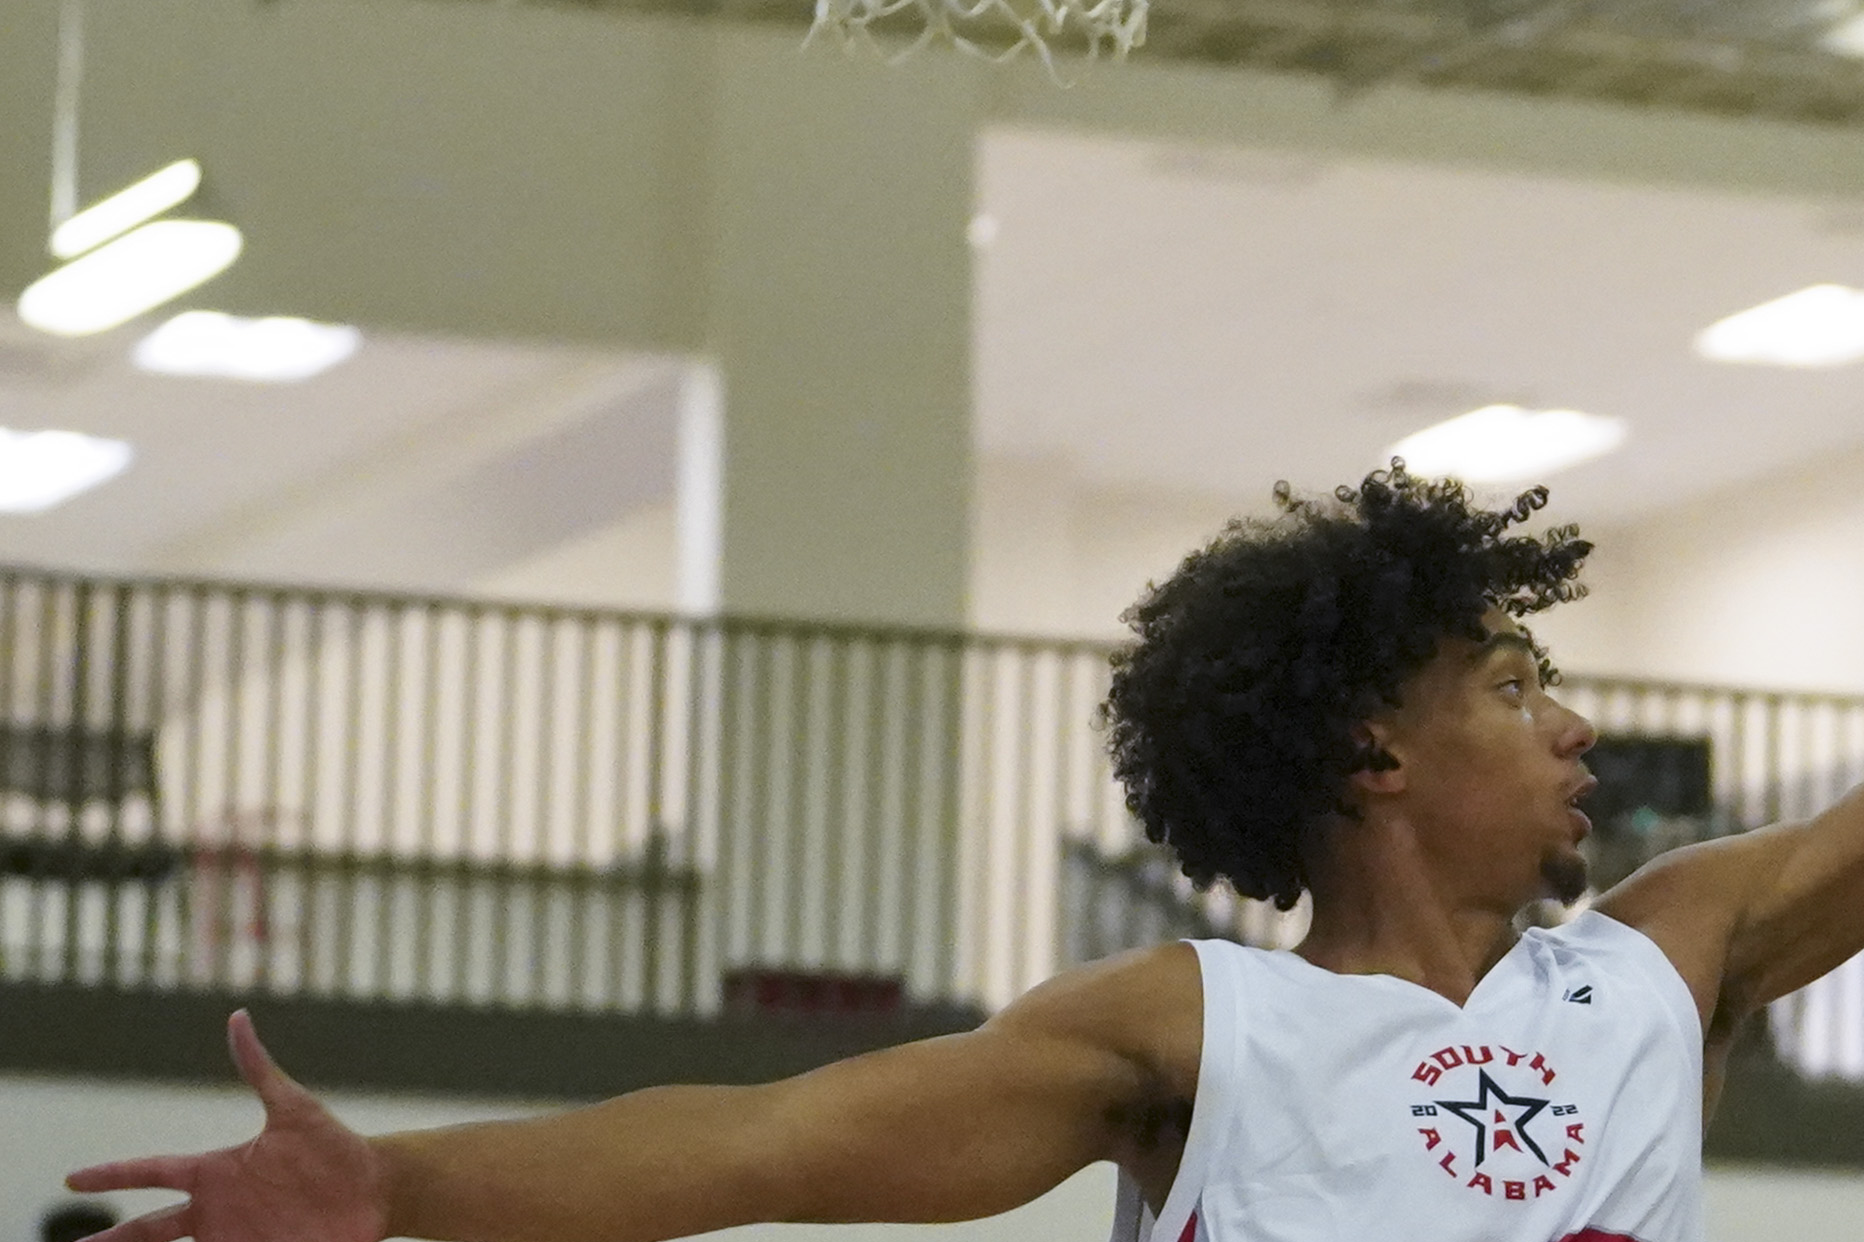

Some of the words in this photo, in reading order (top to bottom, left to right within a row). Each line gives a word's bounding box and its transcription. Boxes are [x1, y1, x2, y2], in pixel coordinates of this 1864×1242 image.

[1411, 1044, 1556, 1088] SOUTH
[1410, 1104, 1438, 1117] 20
[1550, 1103, 1579, 1117] 22
[1417, 1122, 1585, 1201] ALABAMA
